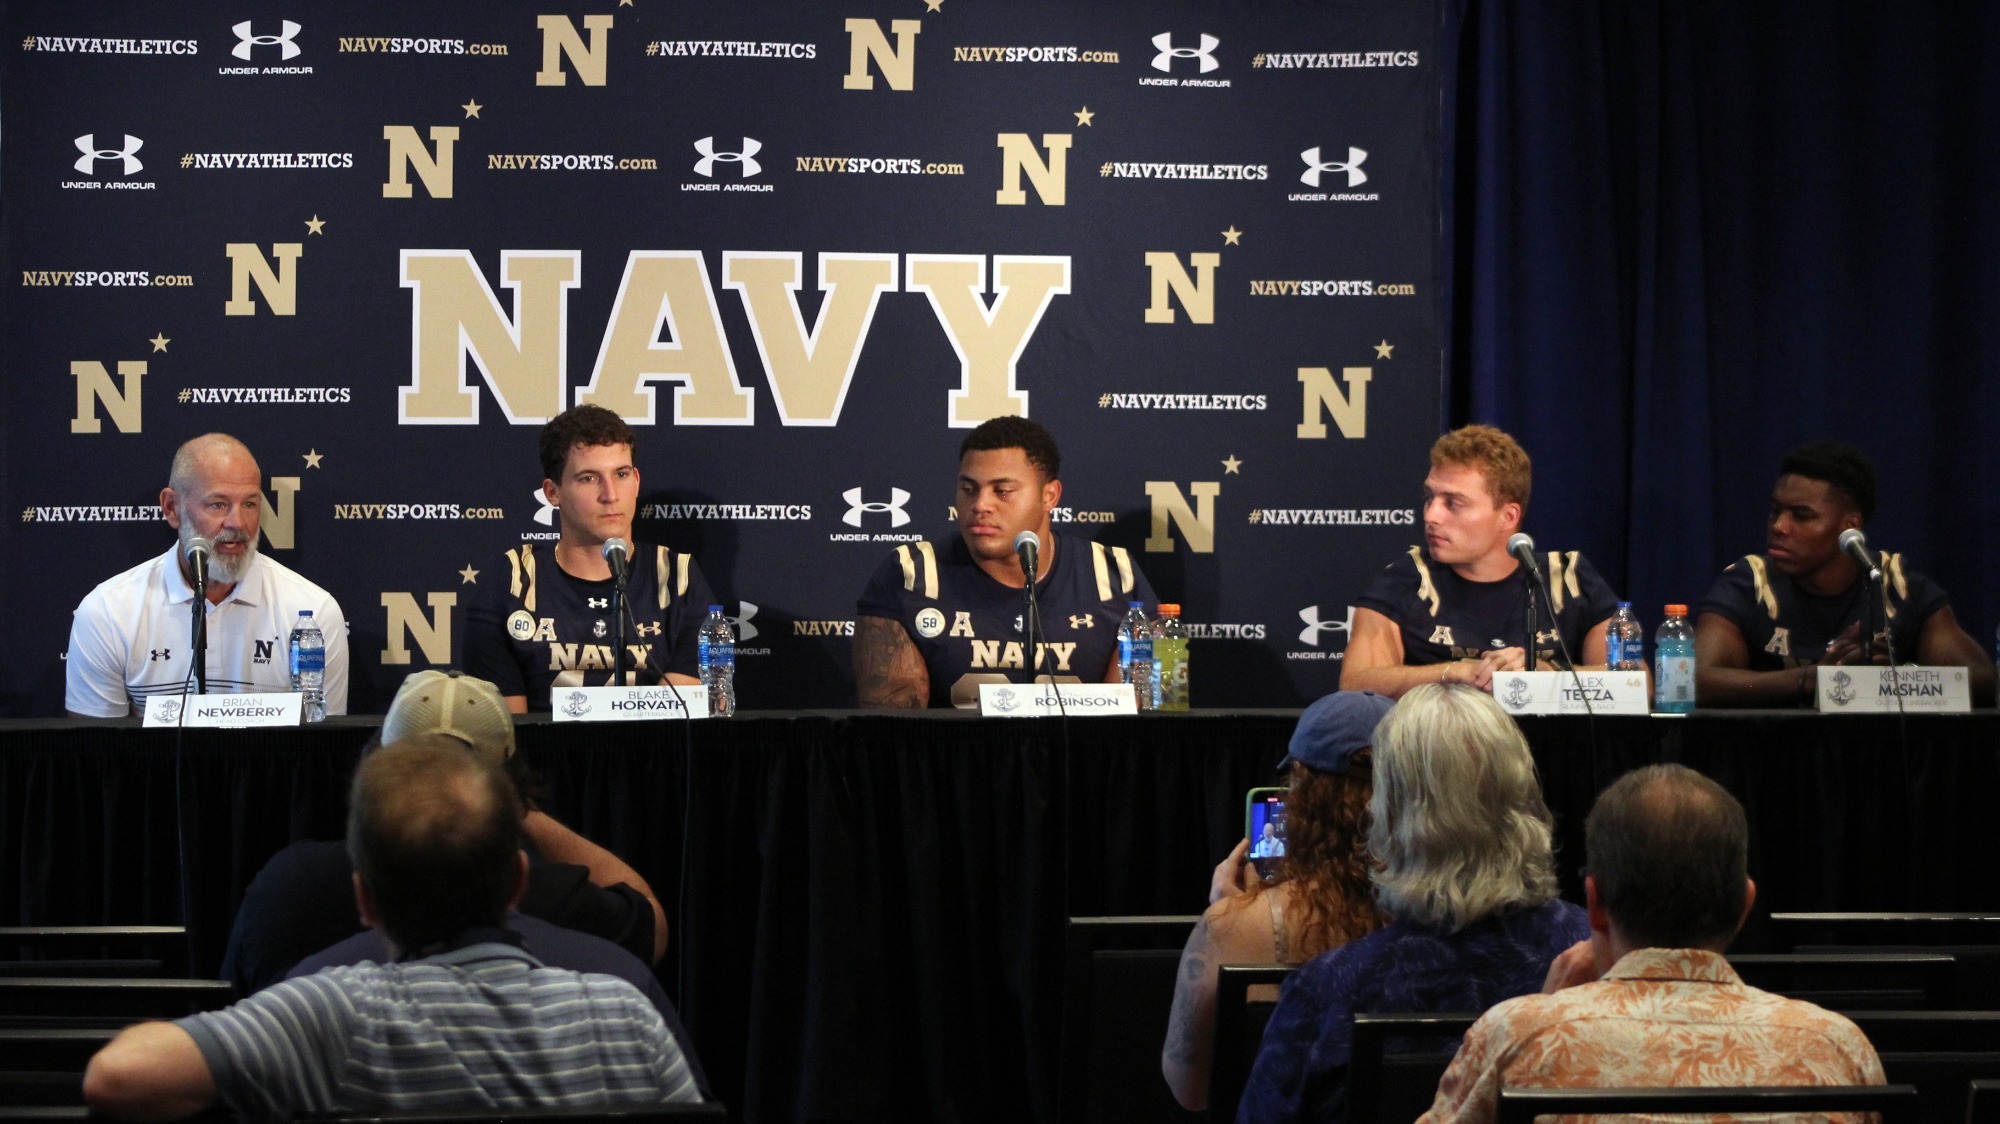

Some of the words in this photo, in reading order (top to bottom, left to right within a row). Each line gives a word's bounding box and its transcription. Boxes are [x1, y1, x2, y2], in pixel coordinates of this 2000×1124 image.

[23, 37, 197, 54] #NAVYATHLETICS
[339, 38, 508, 55] NAVYSPORTS.com
[536, 15, 613, 86] N
[646, 41, 816, 59] #NAVYATHLETICS
[844, 18, 921, 91] N
[954, 46, 1119, 63] NAVYSPORTS.com
[1252, 51, 1418, 68] #NAVYATHLETICS
[1139, 78, 1178, 86] UNDER
[1181, 79, 1231, 87] ARMOUR
[180, 153, 353, 168] #NAVYATHLETICS
[383, 126, 459, 198] N
[488, 155, 657, 170] NAVYSPORTS.com
[796, 157, 964, 174] NAVYSPORTS.com
[996, 133, 1073, 206] N
[1099, 162, 1268, 180] #NAVYATHLETICS
[724, 184, 773, 192] ARMOUR
[1288, 193, 1327, 201] UNDER
[1330, 193, 1379, 201] ARMOUR
[23, 271, 193, 286] NAVYSPORTS.com
[225, 243, 302, 316] N
[1145, 252, 1220, 324] N
[1250, 280, 1415, 296] NAVYSPORTS.com
[398, 248, 1072, 429] NAVY
[71, 361, 147, 433] N
[178, 388, 350, 403] #NAVYATHLETICS
[1098, 393, 1267, 410] #NAVYATHLETICS
[1297, 367, 1372, 439] N
[22, 505, 166, 523] #NAVYATHLET
[335, 504, 504, 519] NAVYSPORTS.com
[641, 504, 812, 521] #NAVYATHLETICS
[1144, 481, 1221, 553] N
[1248, 509, 1414, 524] #NAVYATHLETICS
[521, 532, 561, 540] UNDER
[872, 534, 923, 542] ARMOUR
[380, 591, 458, 665] N
[922, 617, 937, 629] 58
[735, 647, 771, 655] MOUR
[1571, 677, 1604, 688] ALEX
[1879, 671, 1940, 682] KENNETH
[628, 690, 670, 700] BLAKE
[1562, 689, 1614, 701] TECZA
[1878, 683, 1943, 697] McSHAN
[222, 698, 263, 707] BRIAN
[611, 700, 687, 711] HORVATH
[1035, 697, 1120, 707] ROBINSON
[198, 706, 286, 717] NEWBERRY
